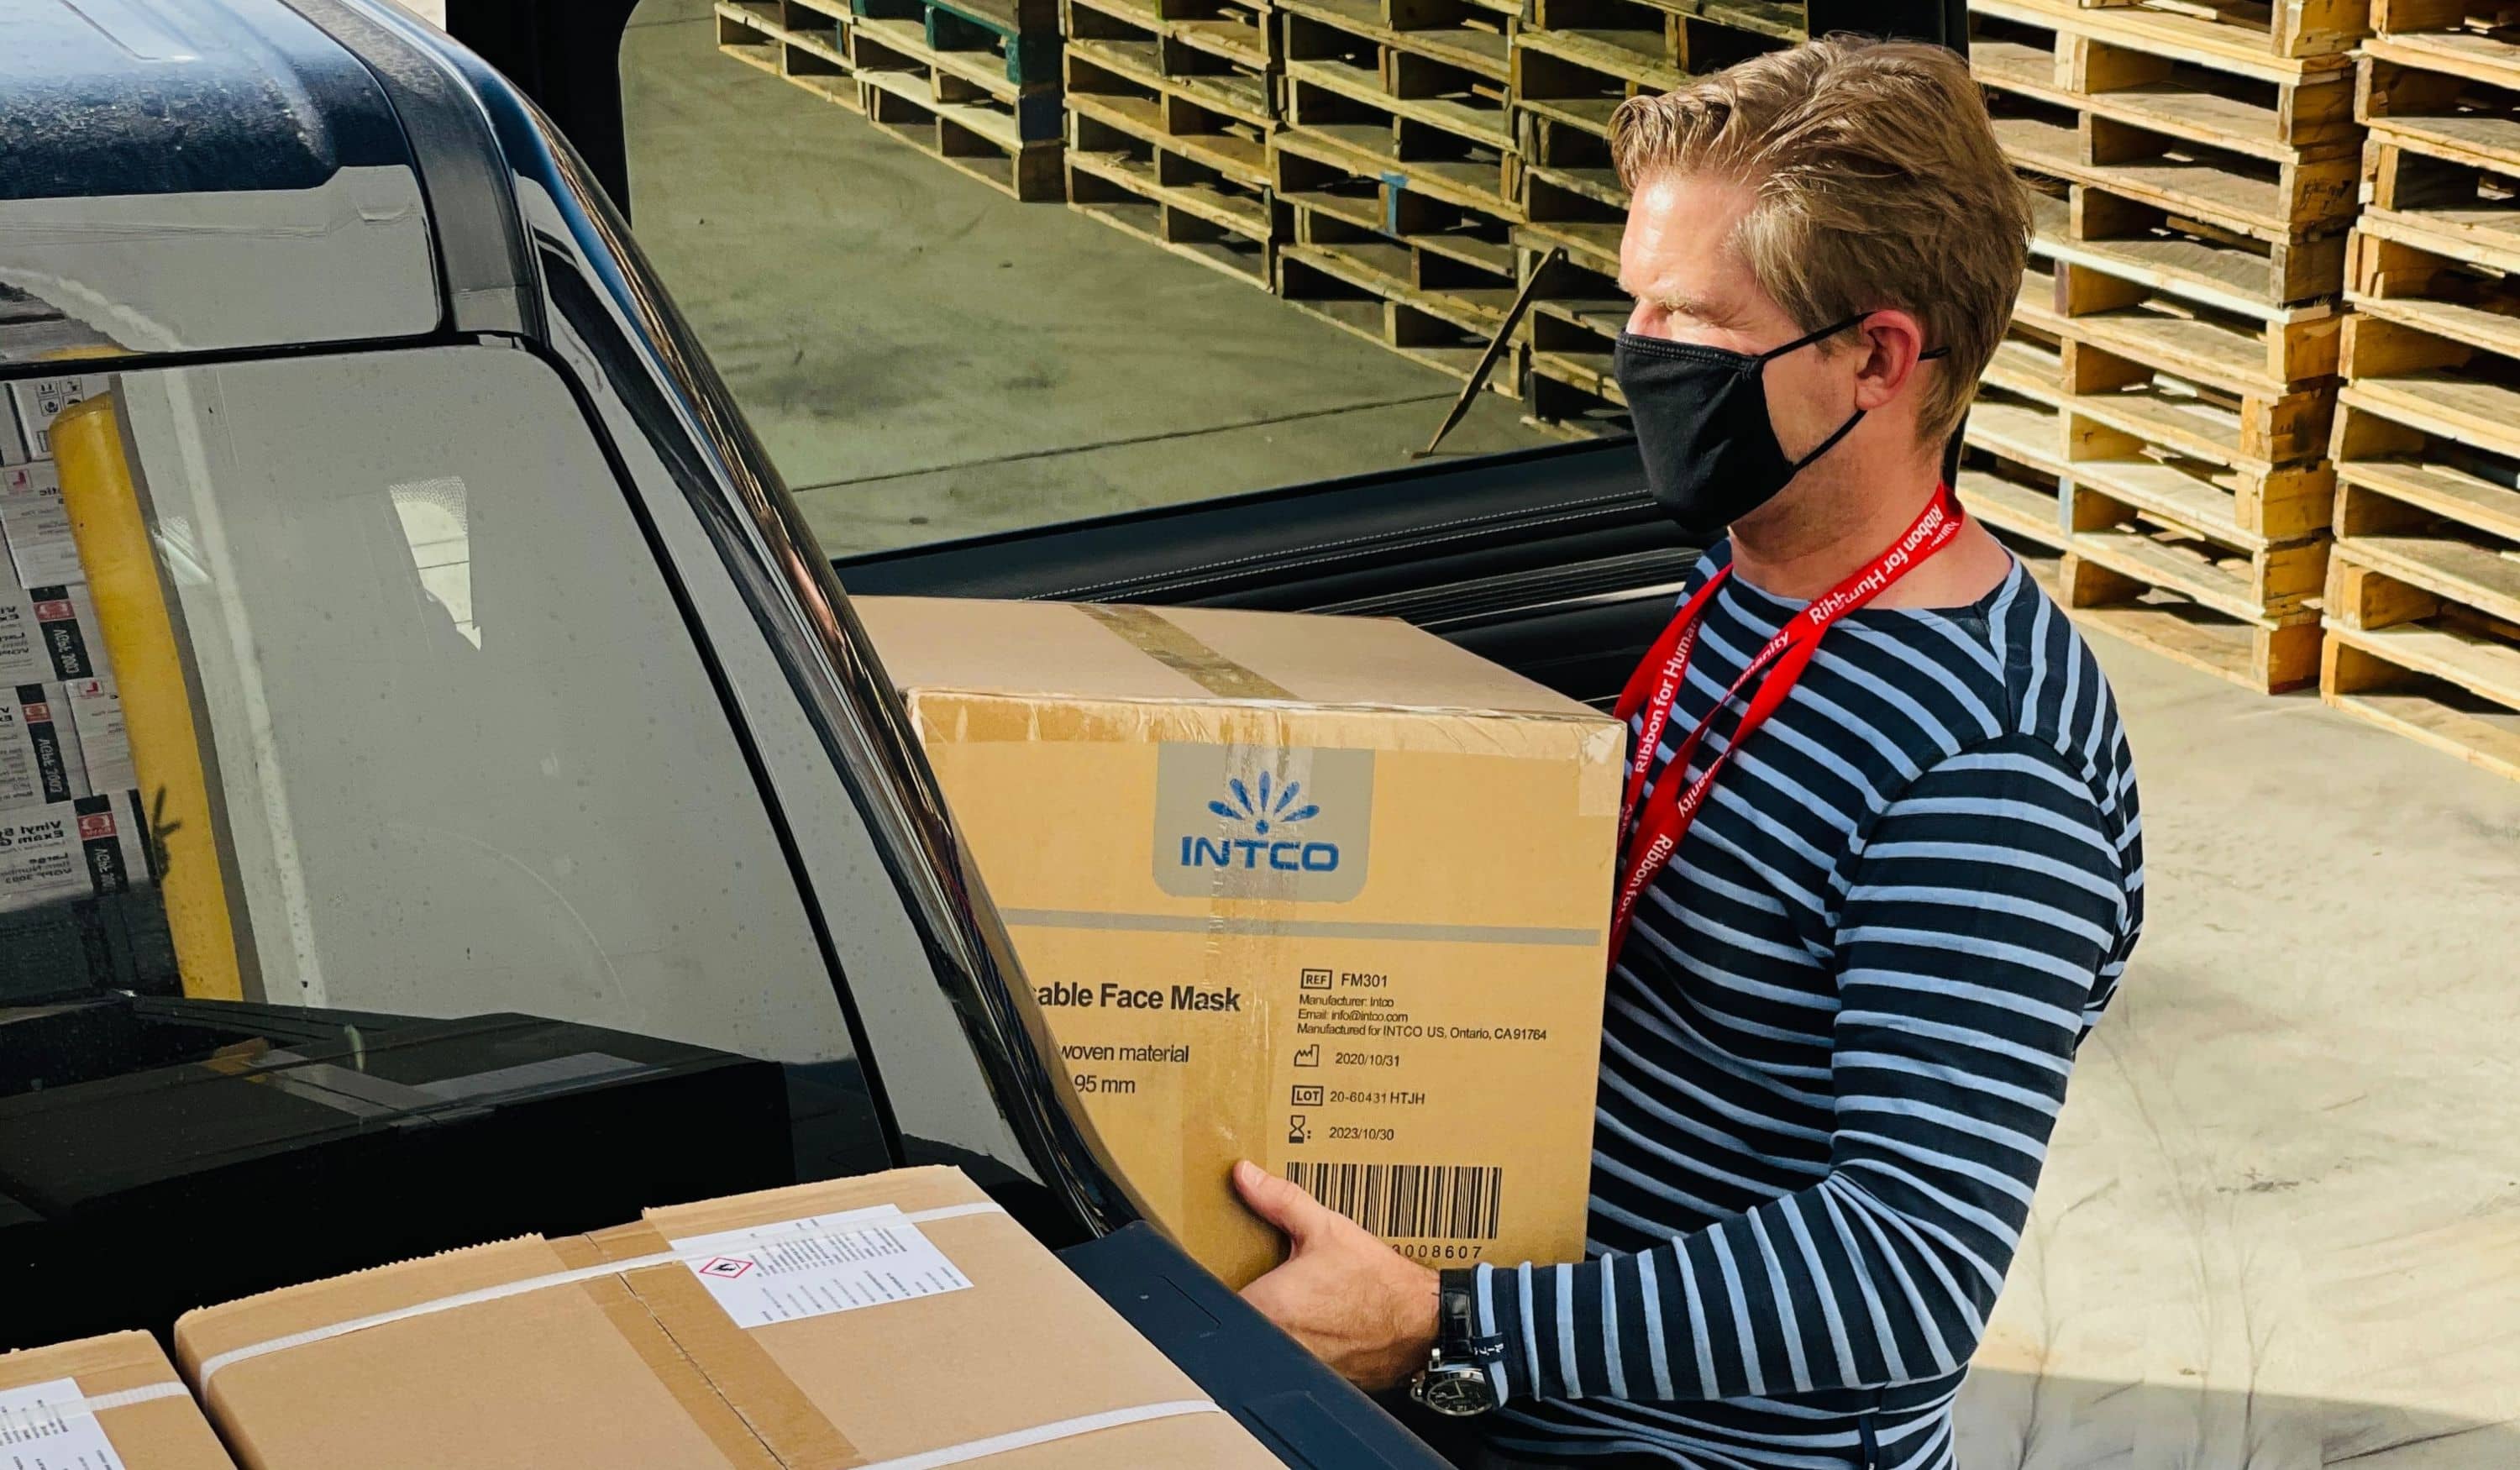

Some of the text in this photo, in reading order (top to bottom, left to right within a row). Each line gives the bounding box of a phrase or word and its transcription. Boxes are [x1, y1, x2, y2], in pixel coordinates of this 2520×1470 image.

[1903, 503, 1944, 552] Ribbon
[1883, 547, 1909, 575] for
[1635, 709, 1664, 774] Ribbon
[1653, 678, 1674, 707] for
[1181, 836, 1339, 871] INTCO
[1630, 833, 1674, 888] Ribbon
[1305, 973, 1388, 988] REF FM301
[1032, 981, 1242, 1011] able Face Mask
[1299, 994, 1394, 1007] Manufacturer: Intco
[1298, 1008, 1409, 1022] Email: info@intco.com
[1297, 1023, 1366, 1035] Manufactured
[1368, 1025, 1382, 1036] for
[1383, 1026, 1422, 1037] INTCO
[1450, 1026, 1492, 1041] Ontario,
[1119, 1043, 1189, 1063] material
[1335, 1052, 1400, 1067] 2020/10/31
[1074, 1074, 1136, 1094] 95 mm
[1296, 1090, 1425, 1105] LOT 20-60431 HTJH
[1329, 1126, 1394, 1141] 2023/10/30
